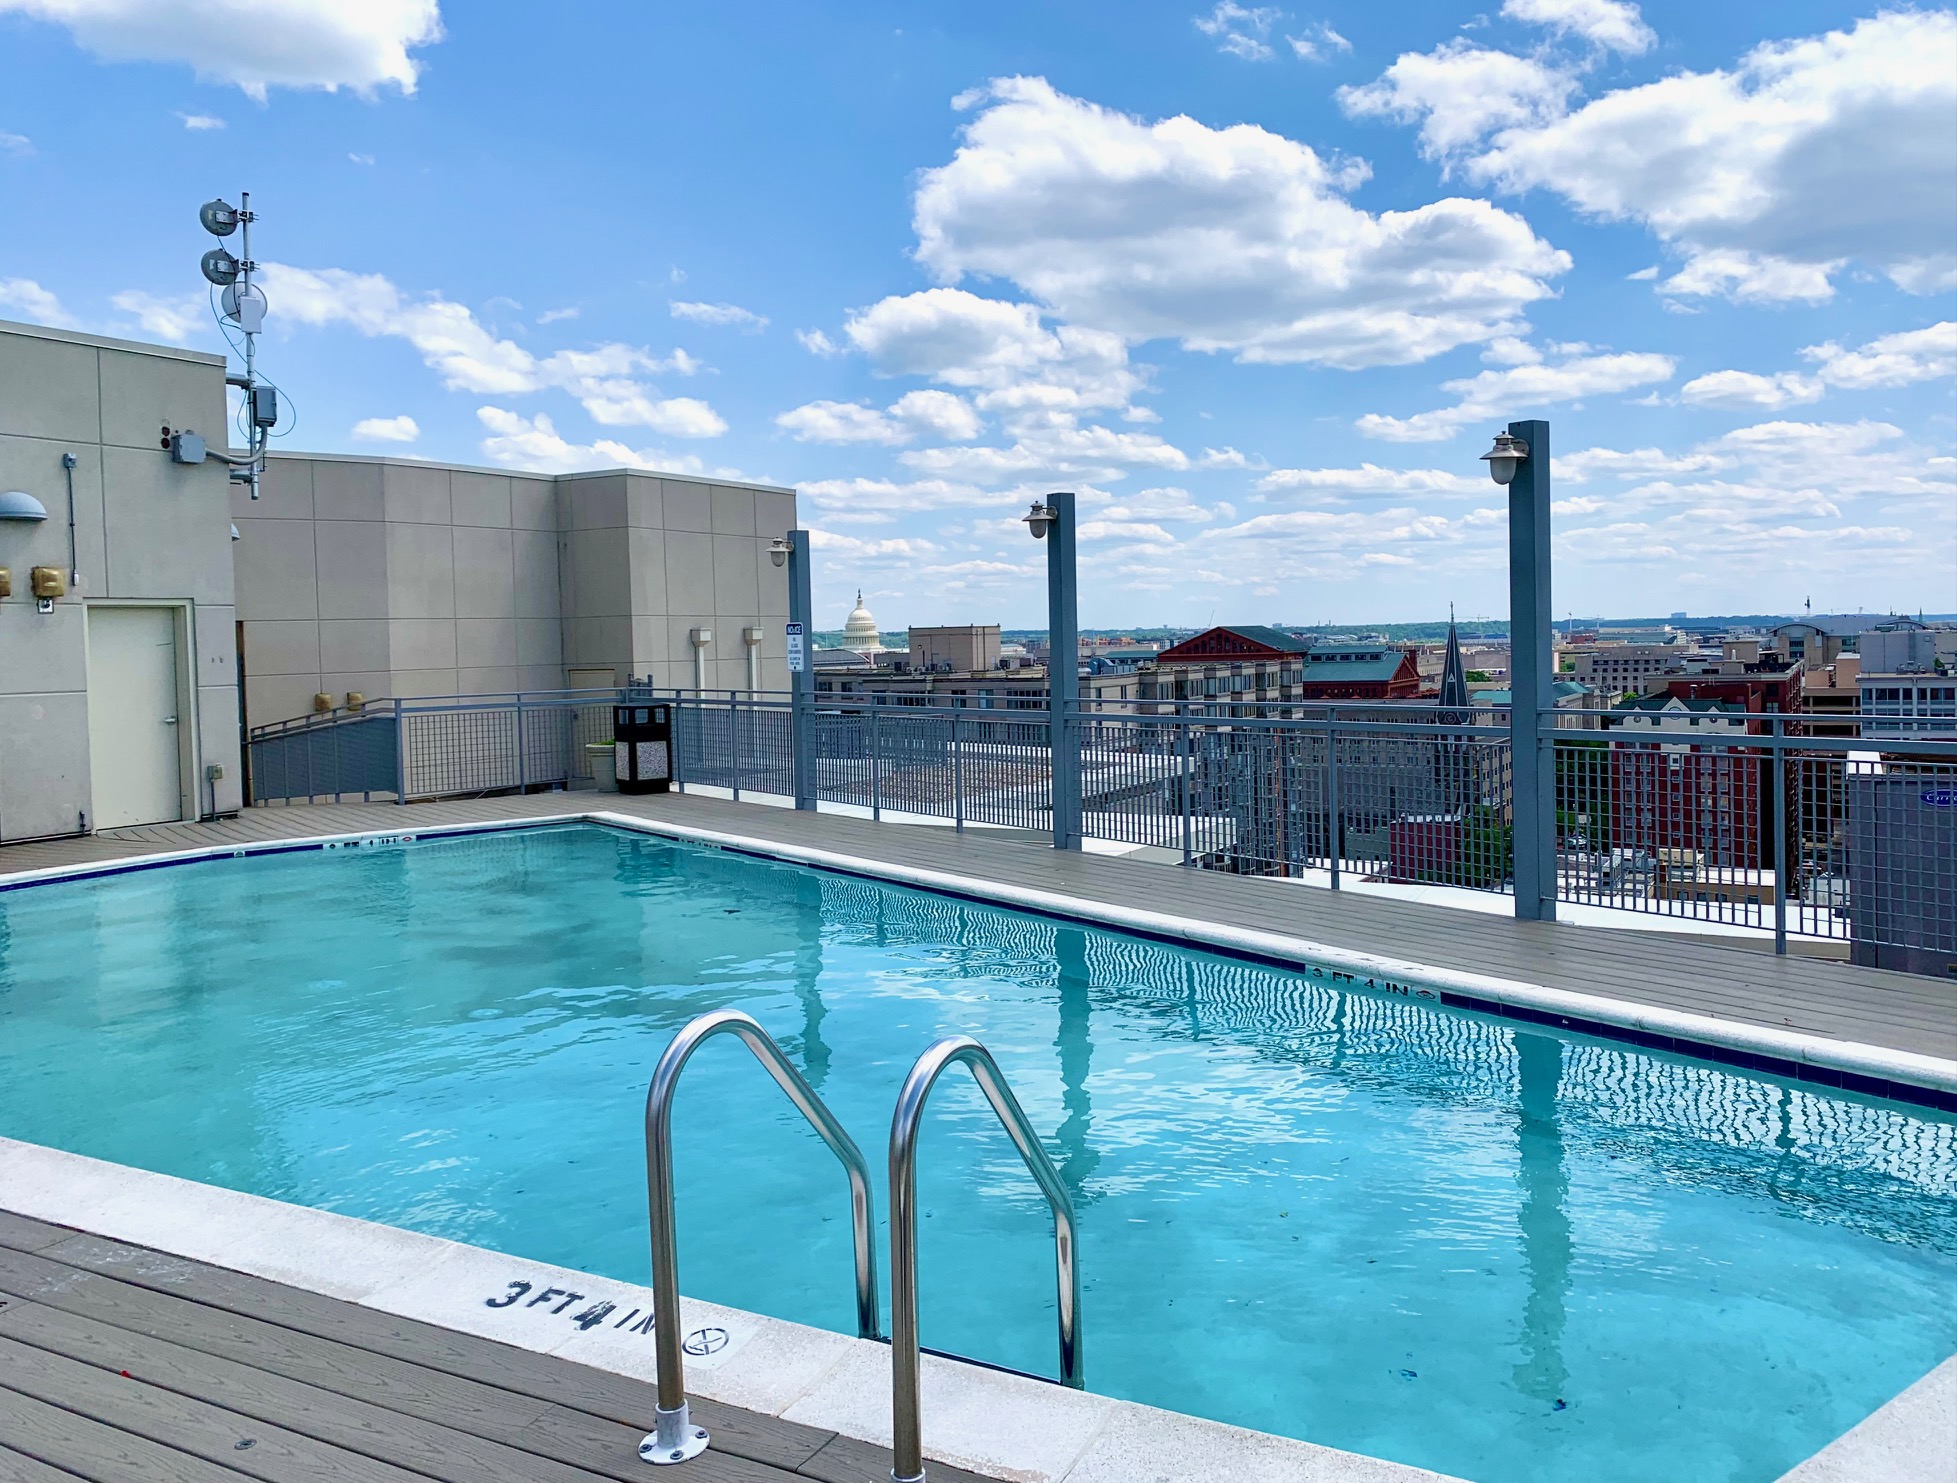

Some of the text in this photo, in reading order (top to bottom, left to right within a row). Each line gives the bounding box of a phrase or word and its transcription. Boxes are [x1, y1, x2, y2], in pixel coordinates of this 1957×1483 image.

[1312, 967, 1408, 996] 3 FT 4 IN
[485, 1279, 656, 1335] 3 FT 4 IN
